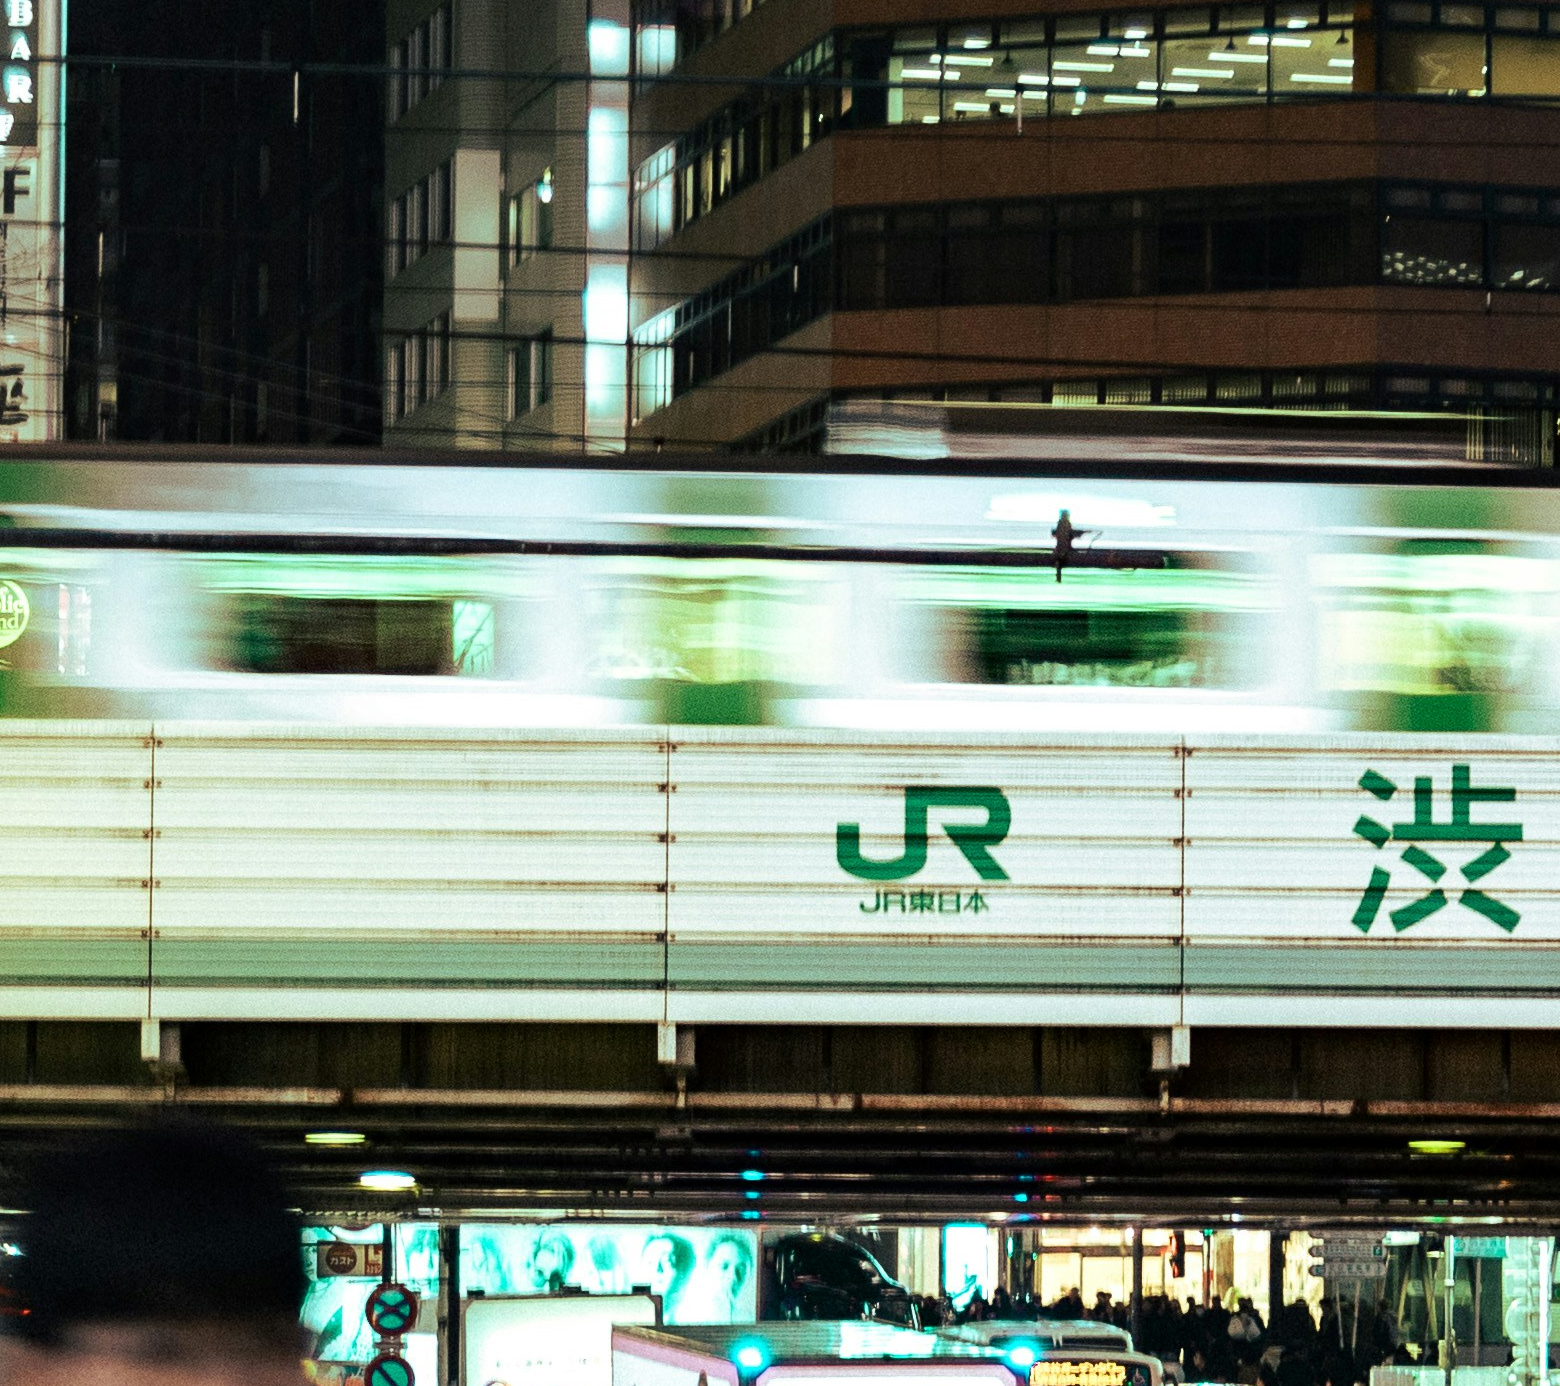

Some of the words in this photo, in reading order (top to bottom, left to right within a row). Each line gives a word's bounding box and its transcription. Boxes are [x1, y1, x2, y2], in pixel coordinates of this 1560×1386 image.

[836, 785, 1011, 881] JR
[858, 888, 990, 915] JR東日本
